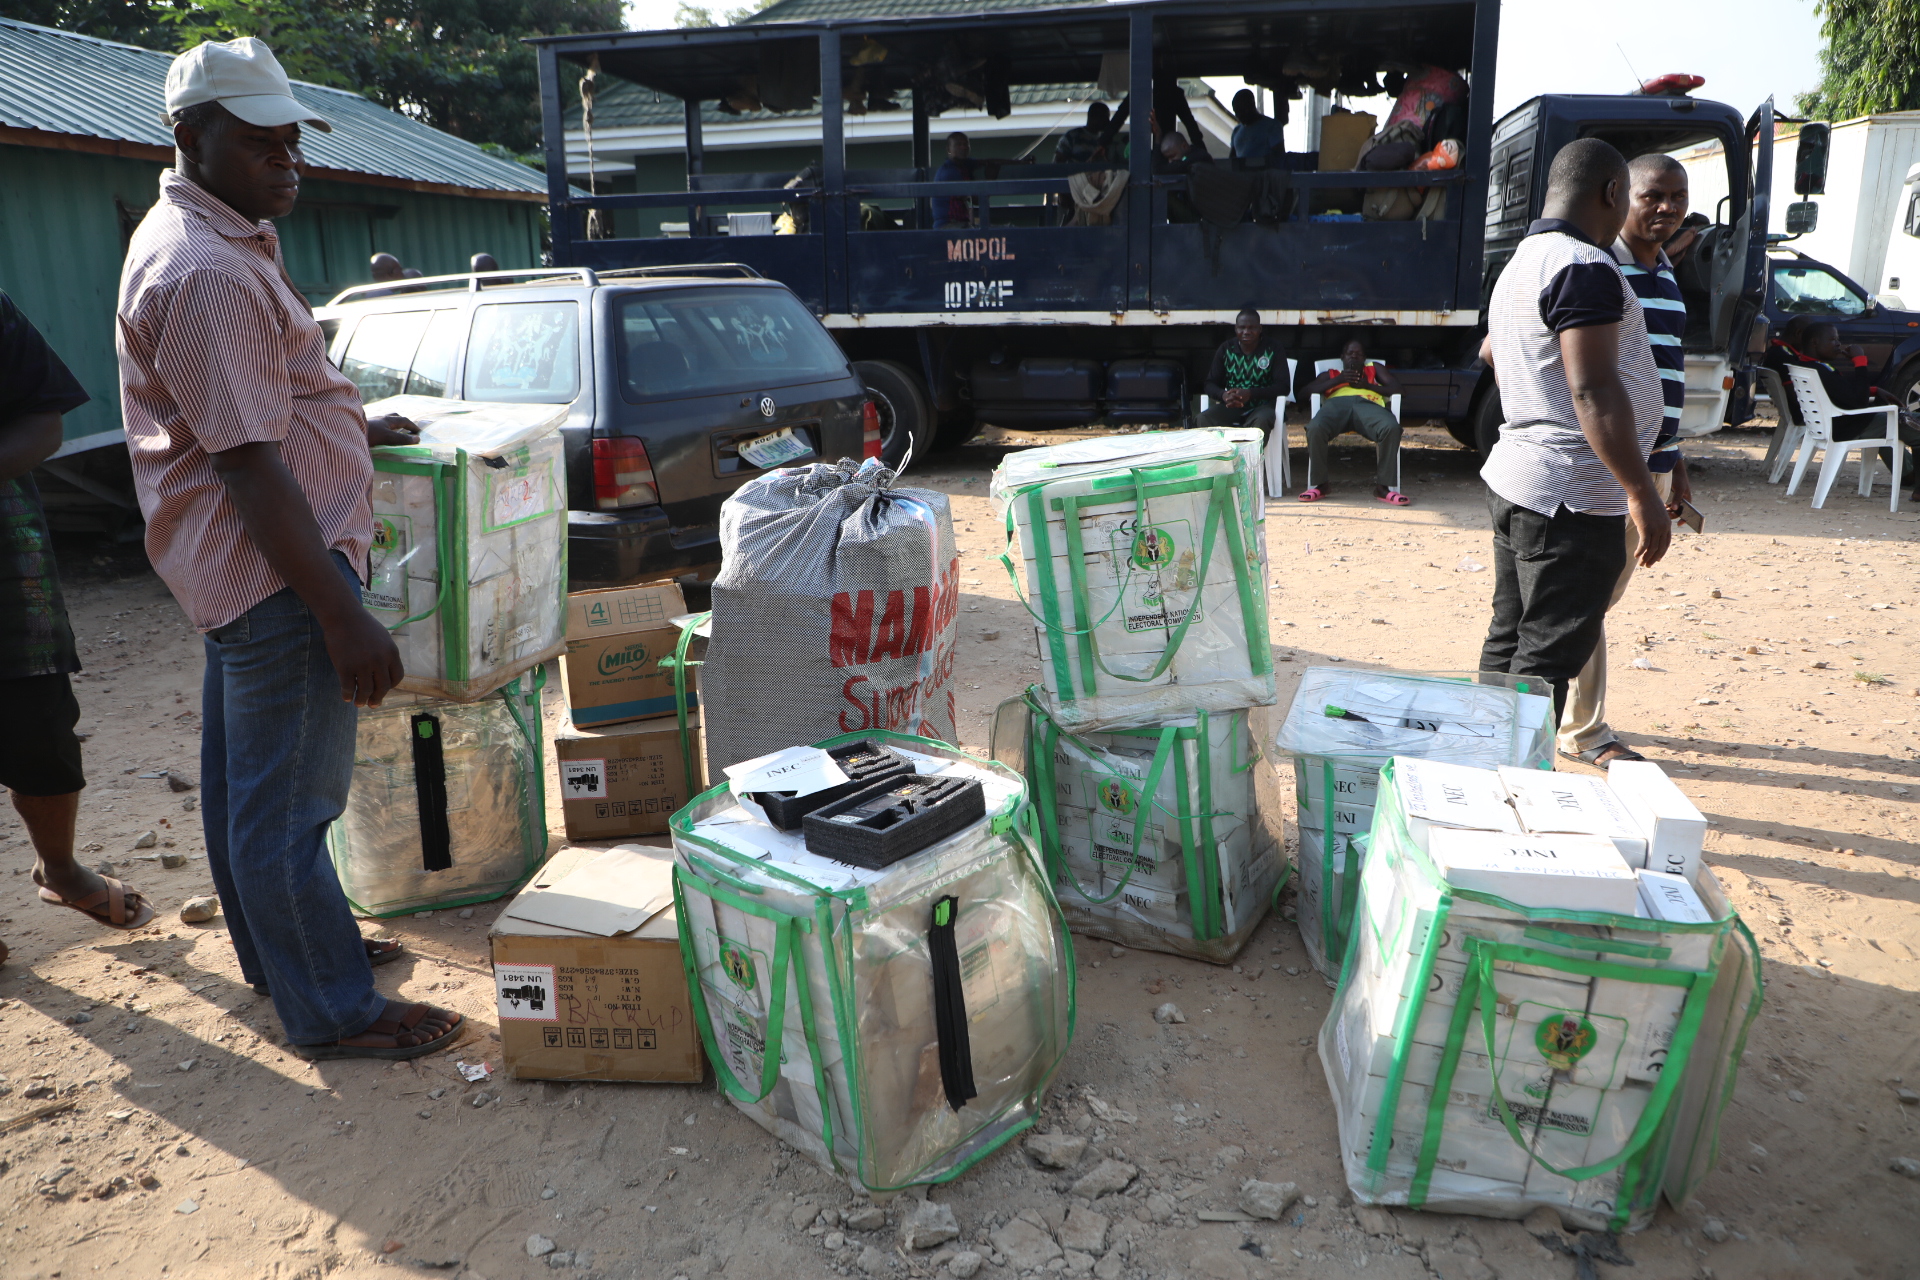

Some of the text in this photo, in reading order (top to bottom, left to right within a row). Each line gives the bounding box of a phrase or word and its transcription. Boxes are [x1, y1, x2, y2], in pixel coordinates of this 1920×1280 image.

[947, 237, 1015, 262] MOPOL
[591, 602, 605, 618] 4
[1128, 620, 1163, 630] ELECTORAL
[606, 649, 645, 669] MILO
[766, 762, 801, 779] INEC
[1333, 780, 1357, 794] NEC
[1441, 783, 1468, 806] INEC
[1551, 790, 1583, 812] INEC
[1124, 893, 1152, 910] INEC
[1660, 884, 1688, 906] INEC
[503, 974, 525, 982] 3481
[621, 1003, 642, 1011] ITEM
[1551, 1112, 1589, 1125] NATIONAL
